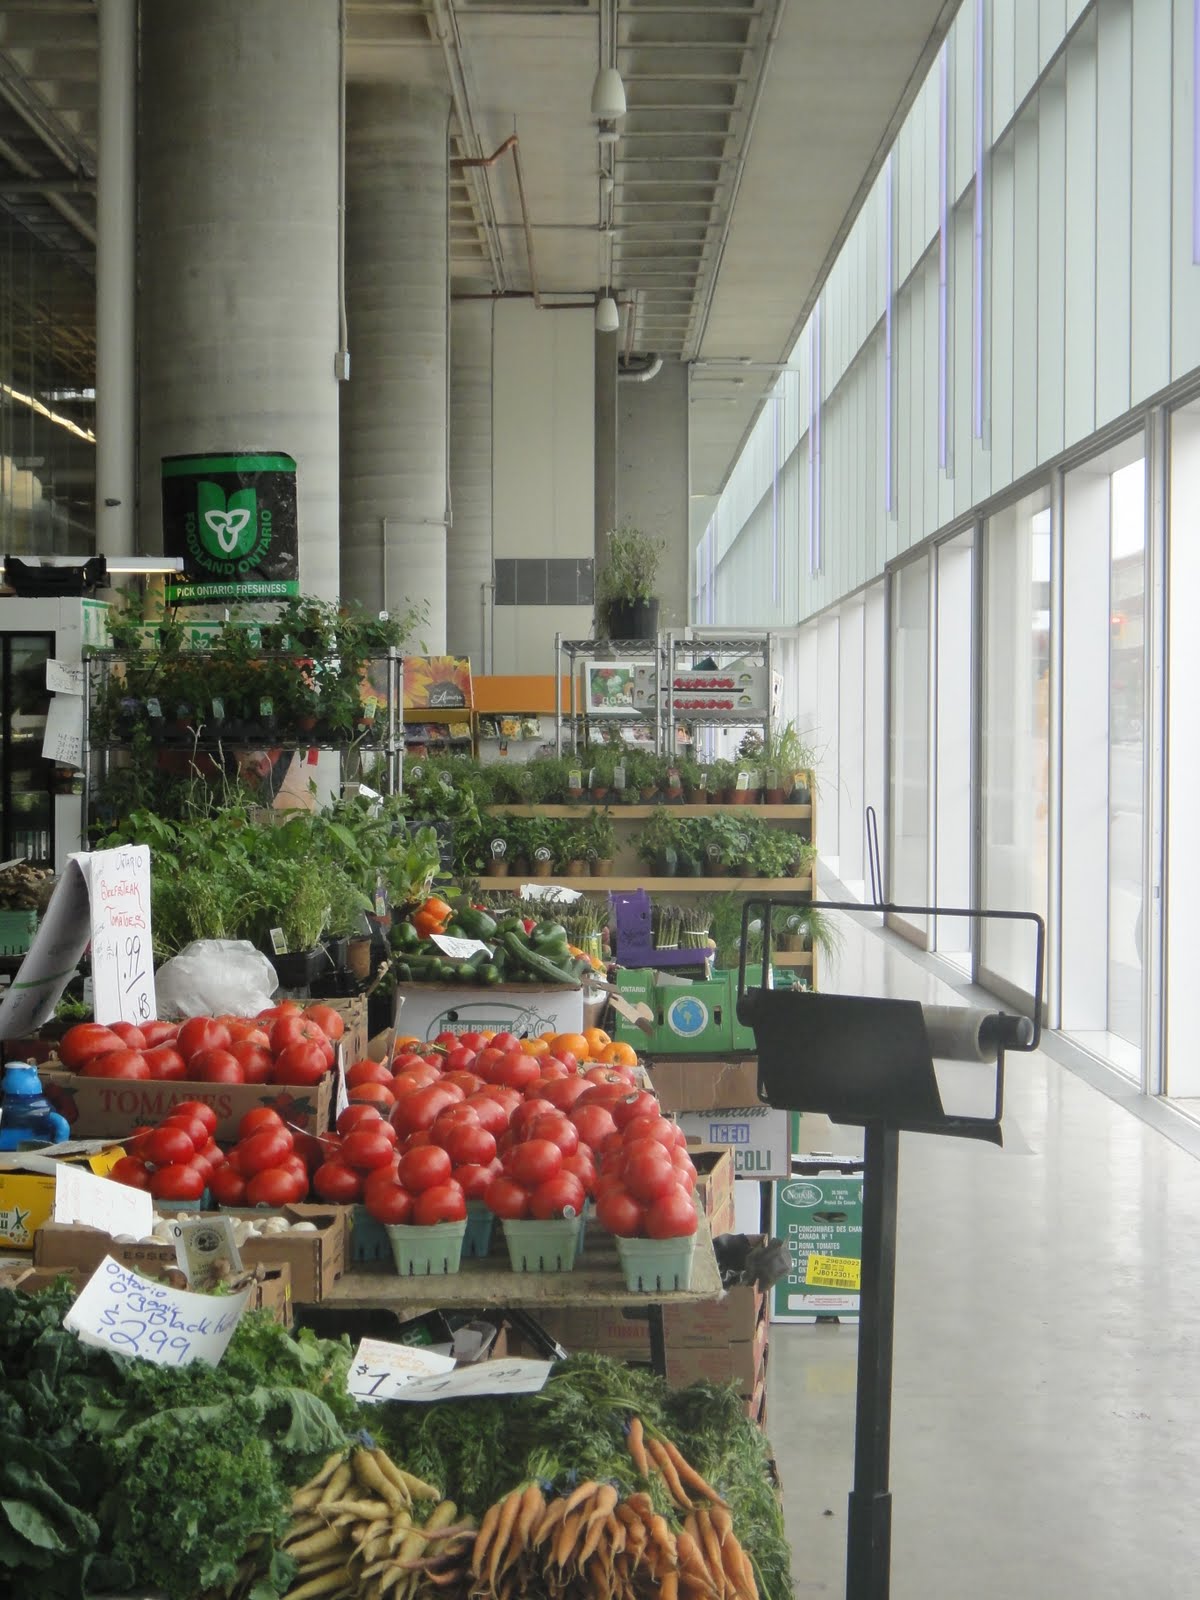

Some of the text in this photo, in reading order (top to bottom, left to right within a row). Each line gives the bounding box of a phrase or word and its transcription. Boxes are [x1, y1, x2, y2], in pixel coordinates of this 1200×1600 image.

[185, 509, 273, 575] FOODLAND ONTARIO
[176, 587, 195, 598] PICK
[236, 583, 288, 594] FRESHNESS
[620, 985, 646, 993] ONTARIO
[441, 1023, 512, 1036] FRESH PRODUCE
[711, 1124, 749, 1143] ICED
[734, 1150, 771, 1171] COLI
[836, 1225, 847, 1233] DES
[798, 1242, 840, 1250] ROMA TOMATES
[106, 1263, 168, 1298] Ontario
[109, 1281, 184, 1315] Organic
[144, 1308, 212, 1336] Black
